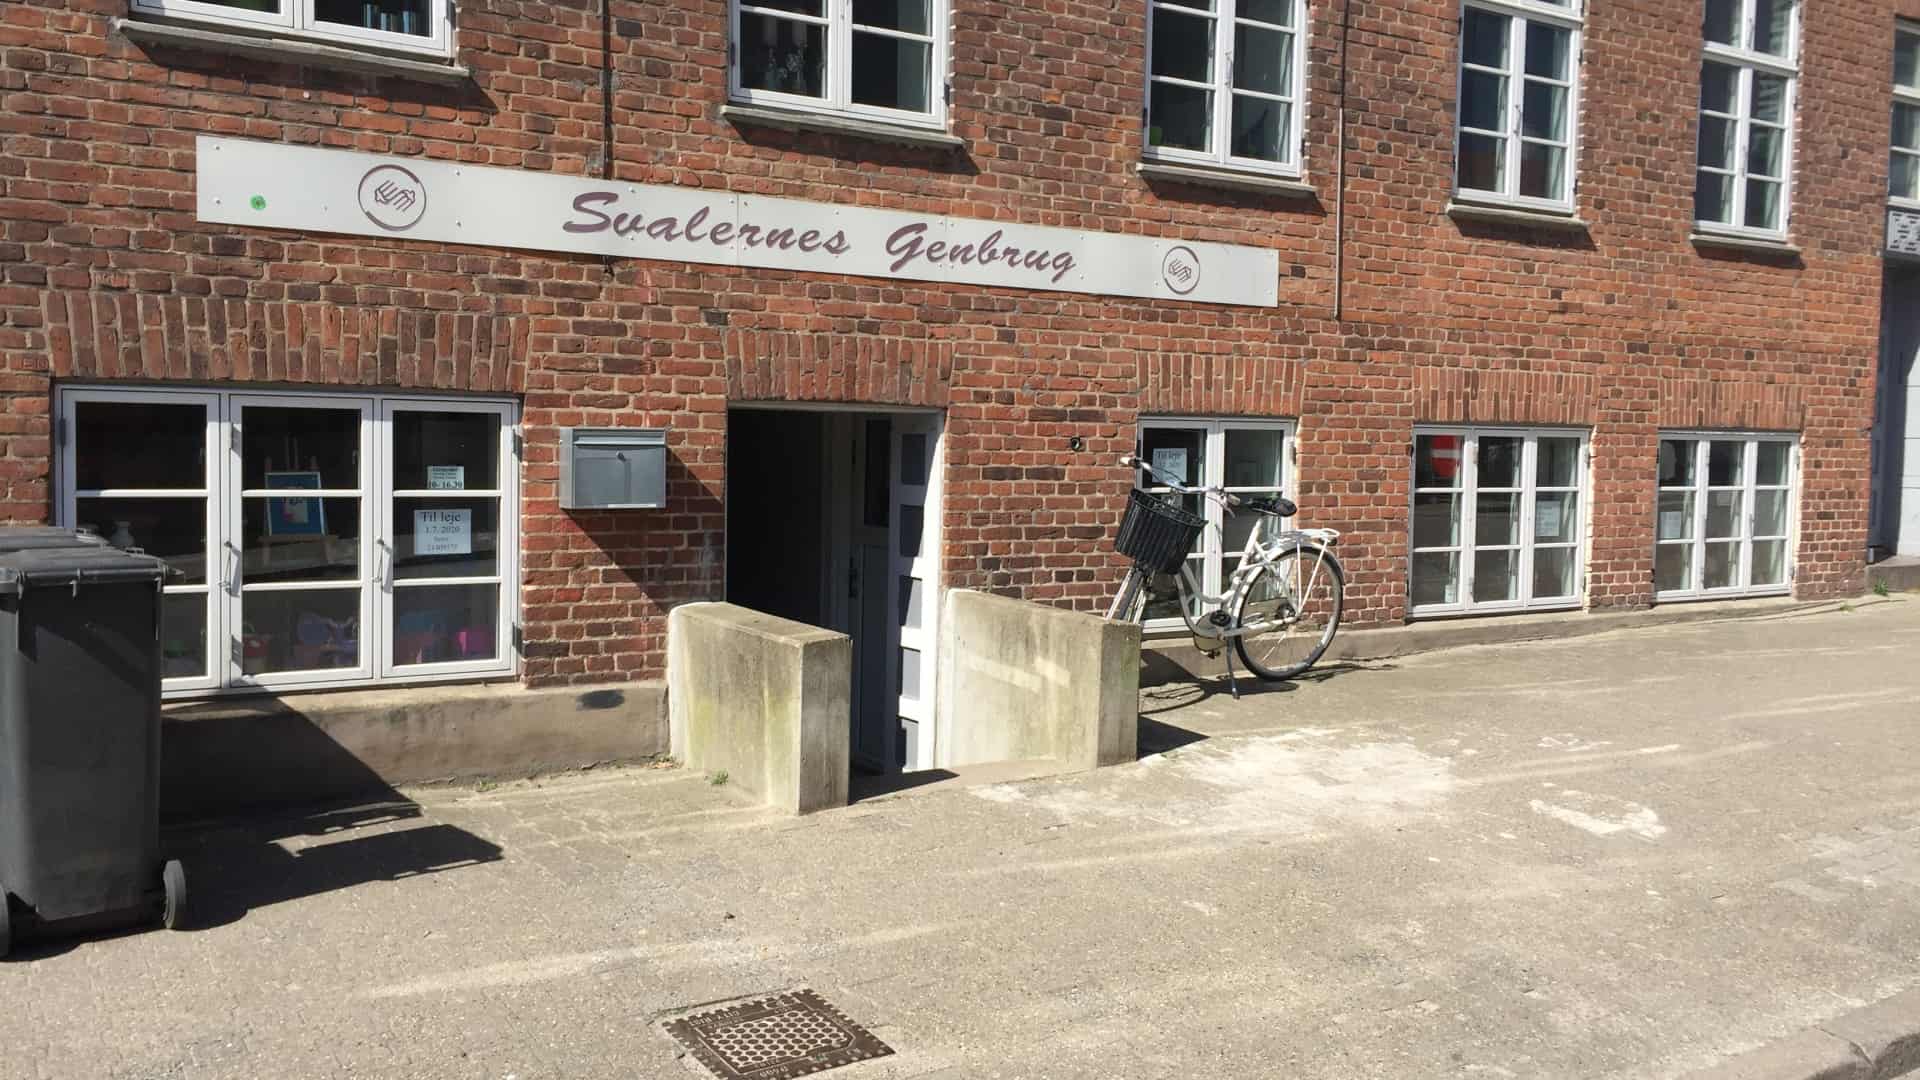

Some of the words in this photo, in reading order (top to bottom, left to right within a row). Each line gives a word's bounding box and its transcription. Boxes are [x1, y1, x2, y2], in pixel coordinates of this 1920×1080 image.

[562, 191, 850, 255] Svalernes
[885, 222, 1076, 283] Genbrug
[421, 512, 437, 522] Til
[440, 511, 461, 525] leje
